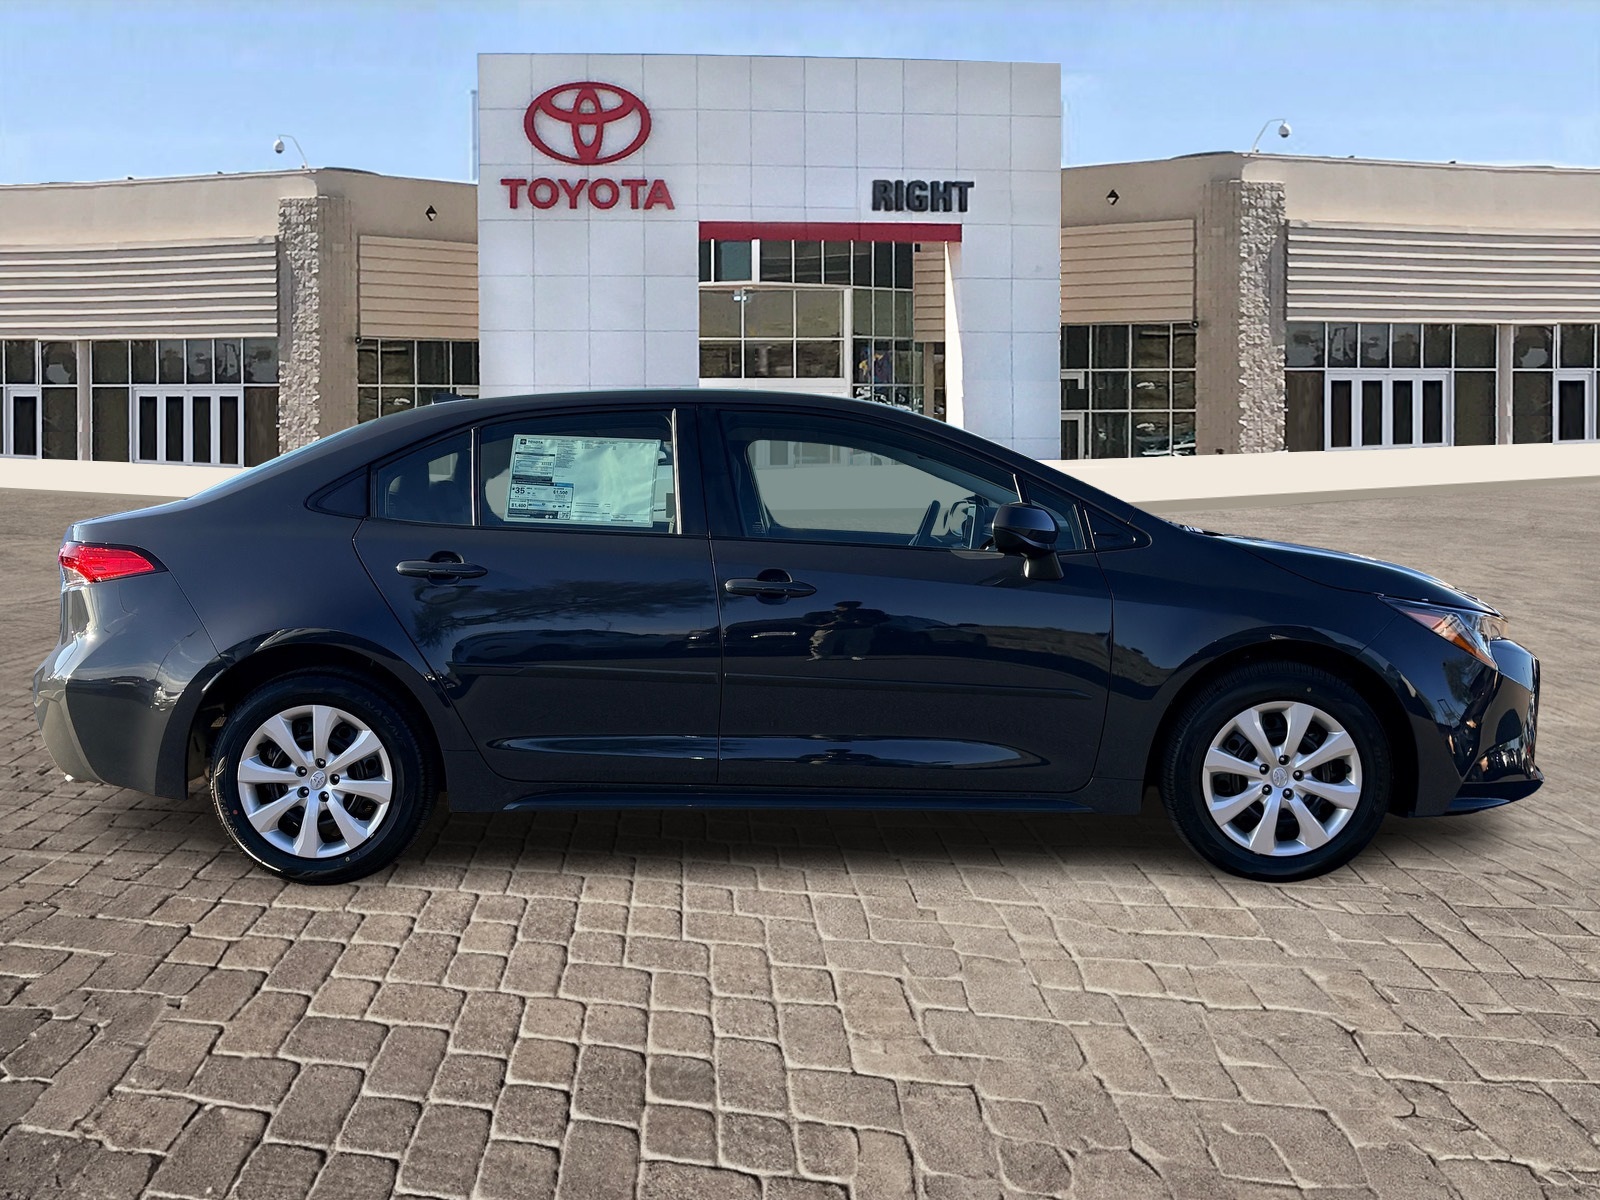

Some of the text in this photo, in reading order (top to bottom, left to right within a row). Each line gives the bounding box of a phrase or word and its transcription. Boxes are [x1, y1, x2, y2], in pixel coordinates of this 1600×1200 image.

[500, 178, 675, 209] TOYOTA
[872, 179, 975, 212] RIGHT
[515, 487, 526, 495] 35
